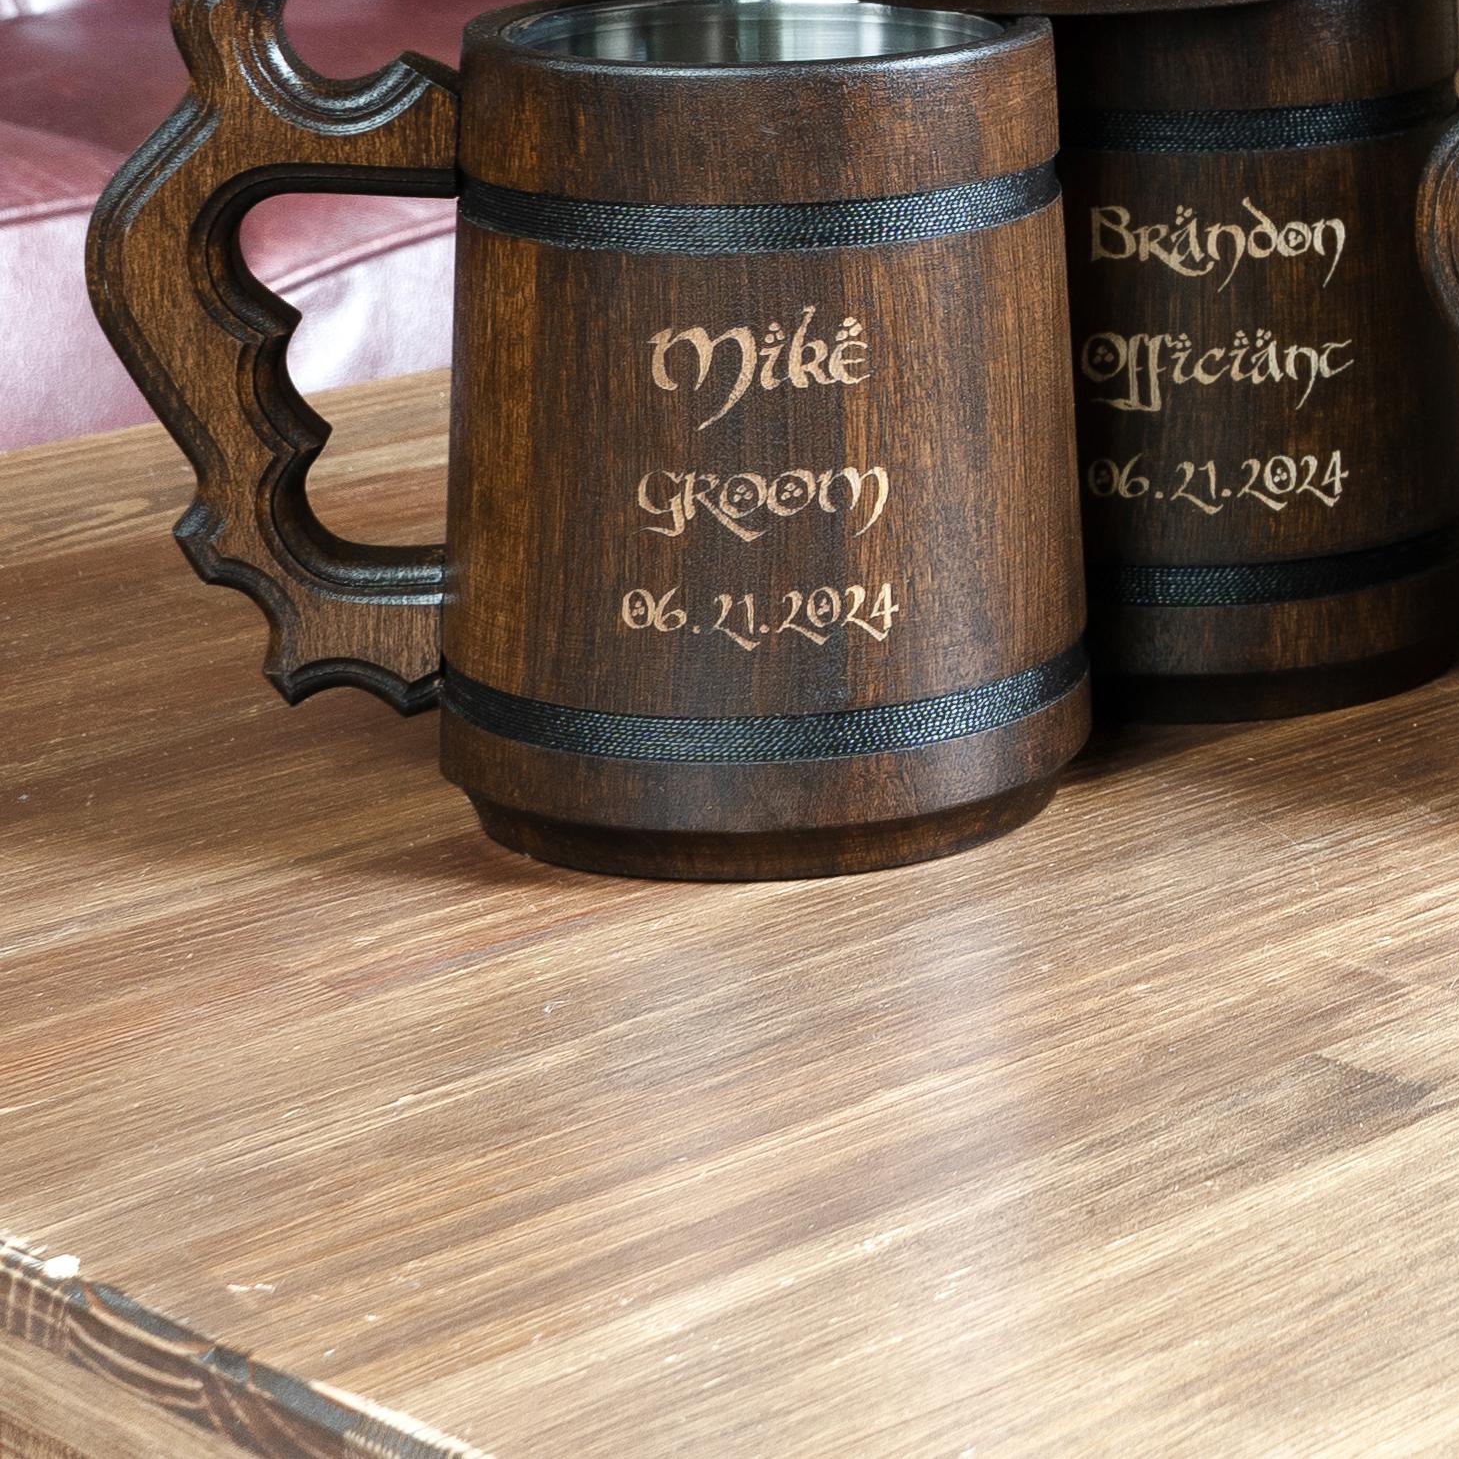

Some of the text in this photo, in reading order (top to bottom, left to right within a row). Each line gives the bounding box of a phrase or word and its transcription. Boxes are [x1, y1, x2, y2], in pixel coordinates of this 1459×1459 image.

[1090, 196, 1347, 293] Brandon
[646, 304, 873, 431] Mike
[1081, 328, 1354, 412] Officiant
[1086, 450, 1349, 516] 06.21.2024
[621, 582, 900, 652] 06.21.2024
